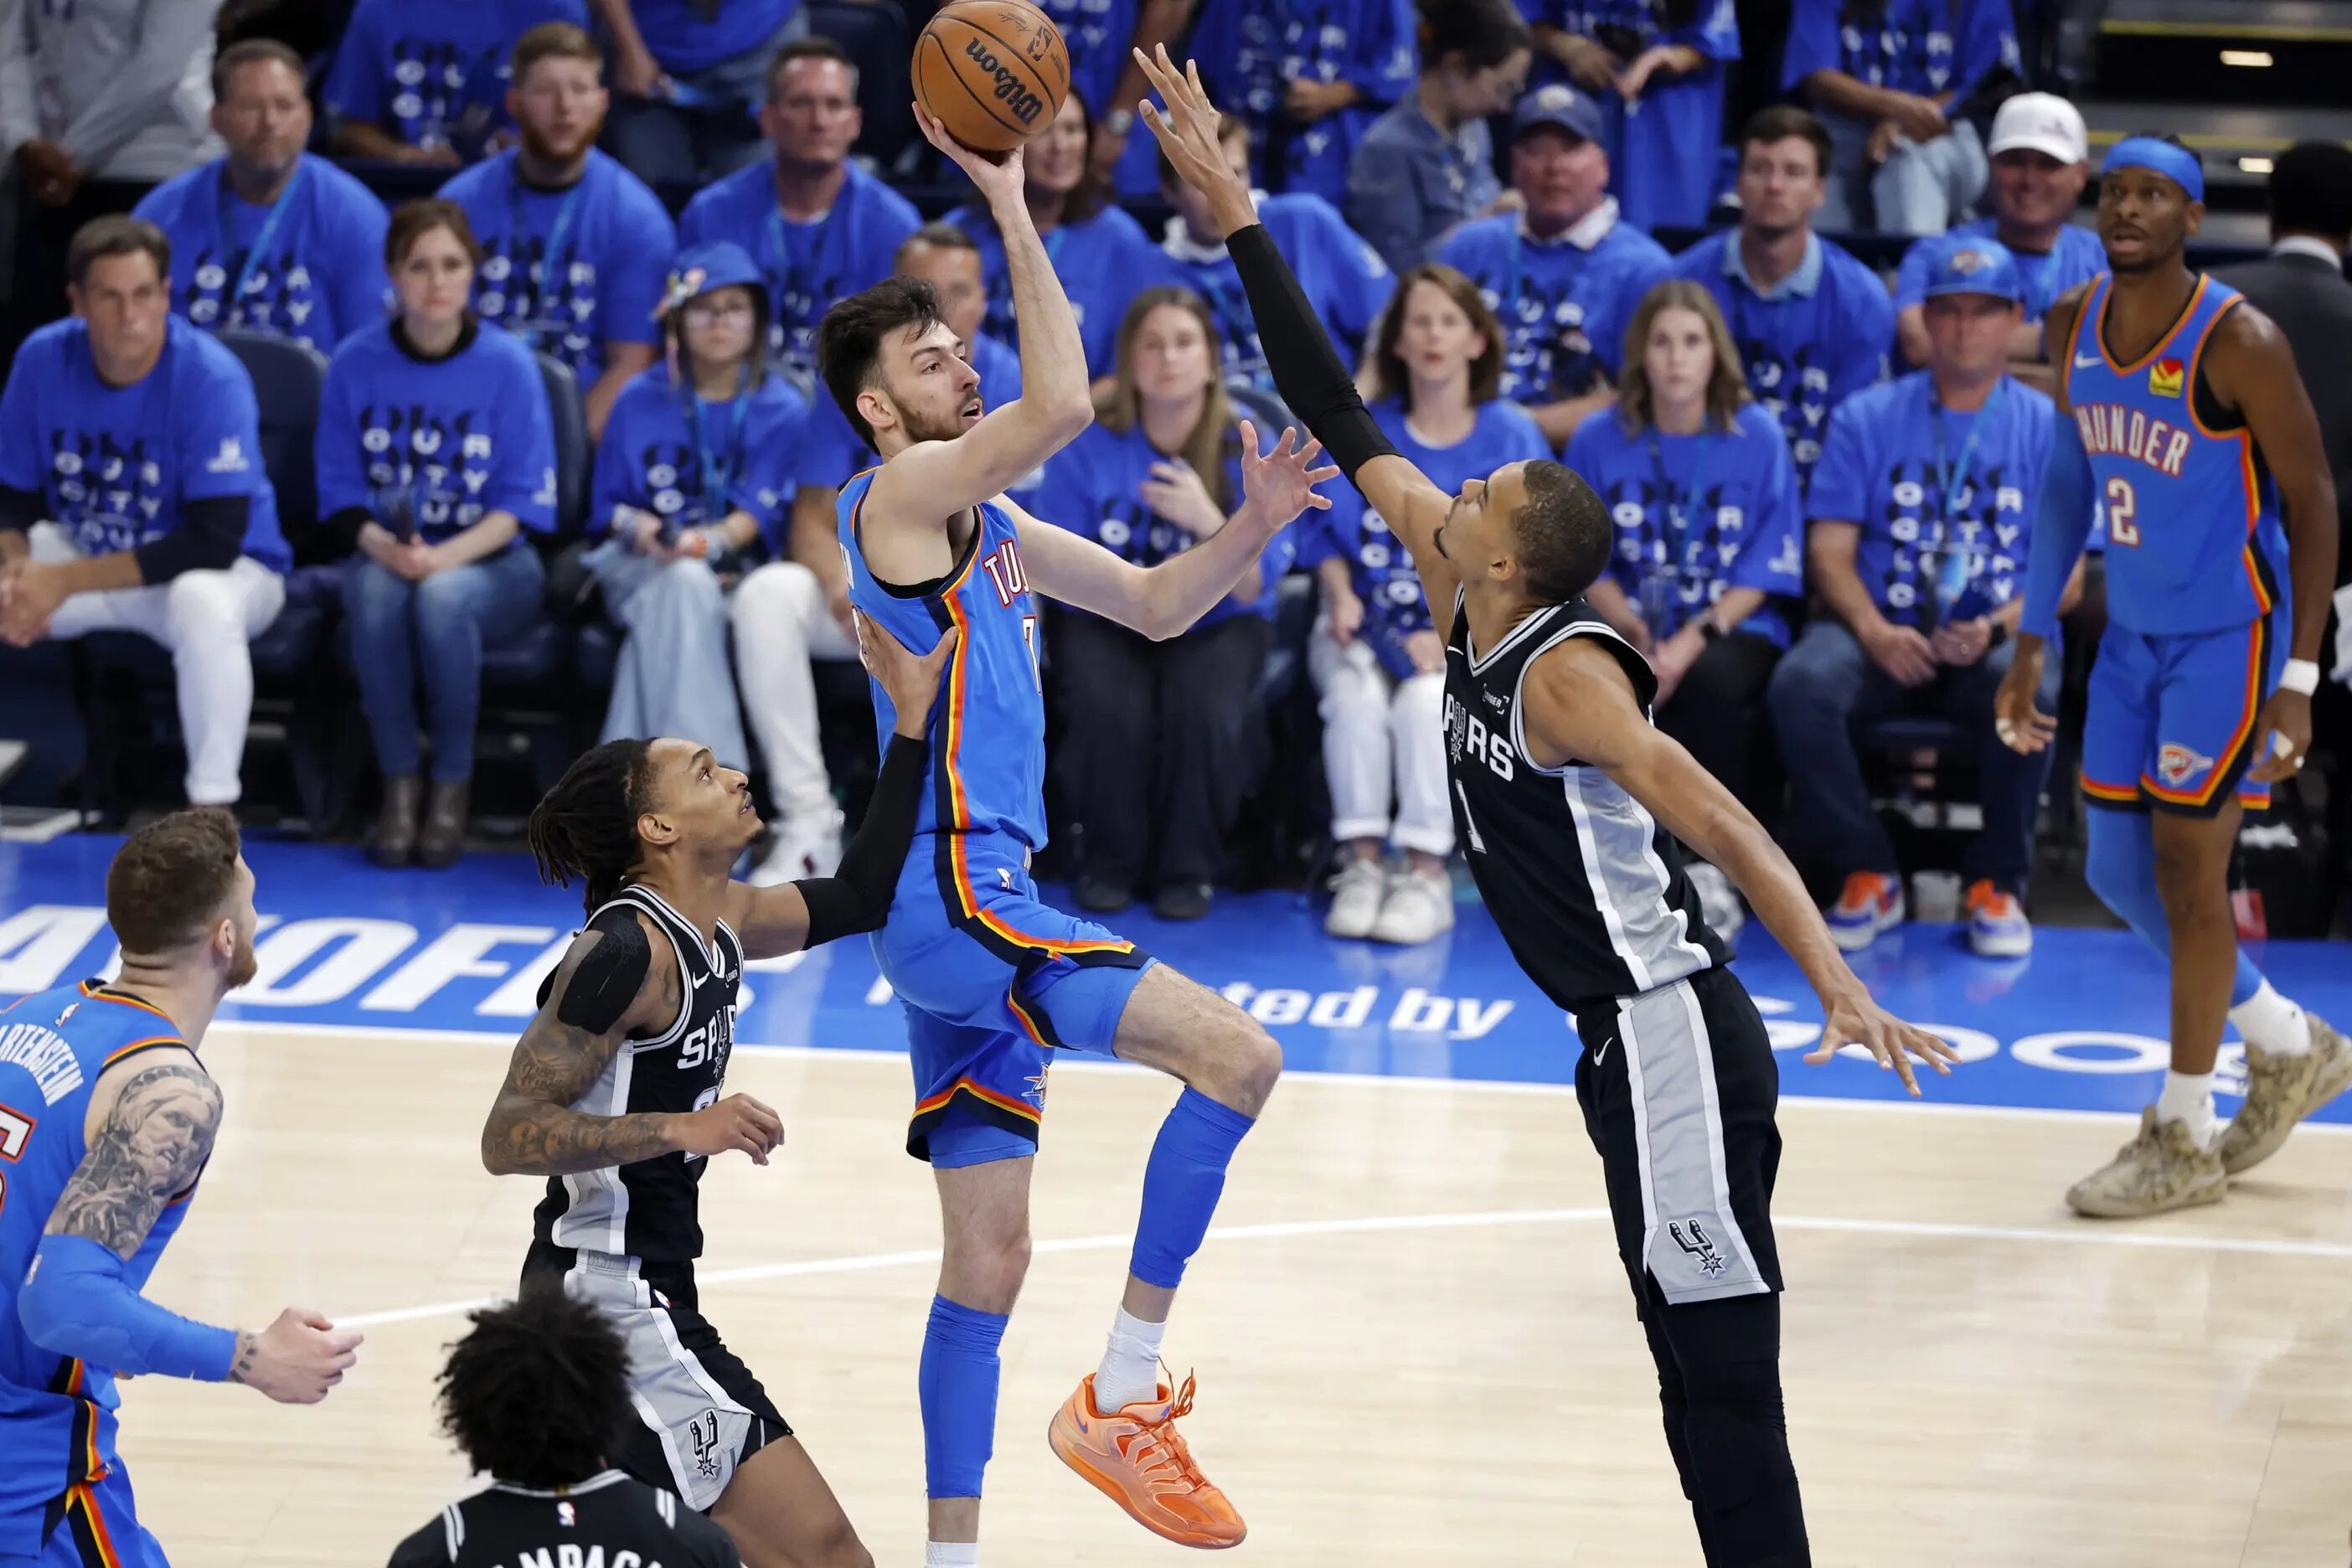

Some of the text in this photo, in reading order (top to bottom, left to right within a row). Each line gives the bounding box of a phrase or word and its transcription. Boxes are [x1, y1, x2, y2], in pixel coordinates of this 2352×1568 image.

[362, 427, 492, 461] OUR
[2106, 476, 2139, 546] 2
[1456, 779, 1488, 854] 1
[1389, 988, 1514, 1040] by
